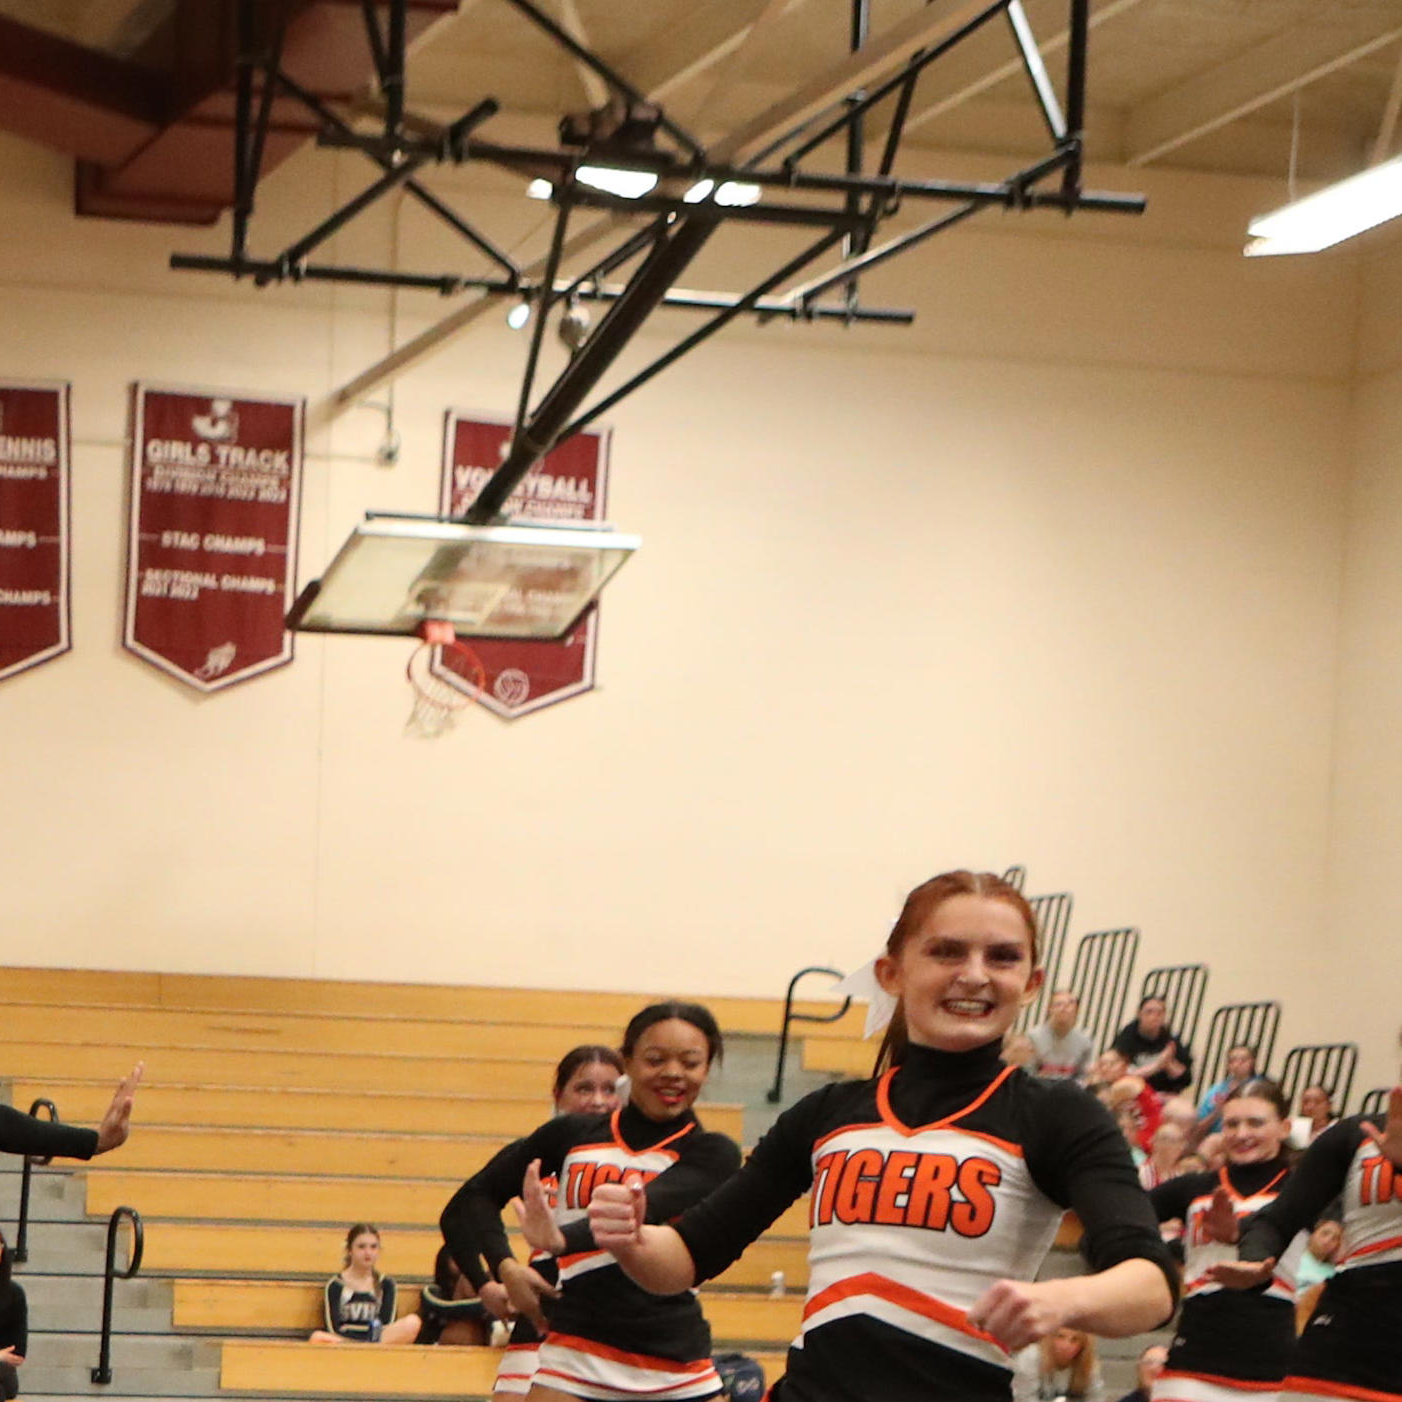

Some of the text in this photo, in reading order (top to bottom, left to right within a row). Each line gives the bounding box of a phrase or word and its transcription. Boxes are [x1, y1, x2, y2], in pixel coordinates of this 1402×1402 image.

[147, 438, 290, 476] GIRLS TRACK
[456, 464, 594, 504] VOYBALL
[161, 530, 266, 556] STAC CHAMPS
[146, 568, 276, 595] SECTIONAL CHAMPS
[810, 1148, 1001, 1237] TIGERS
